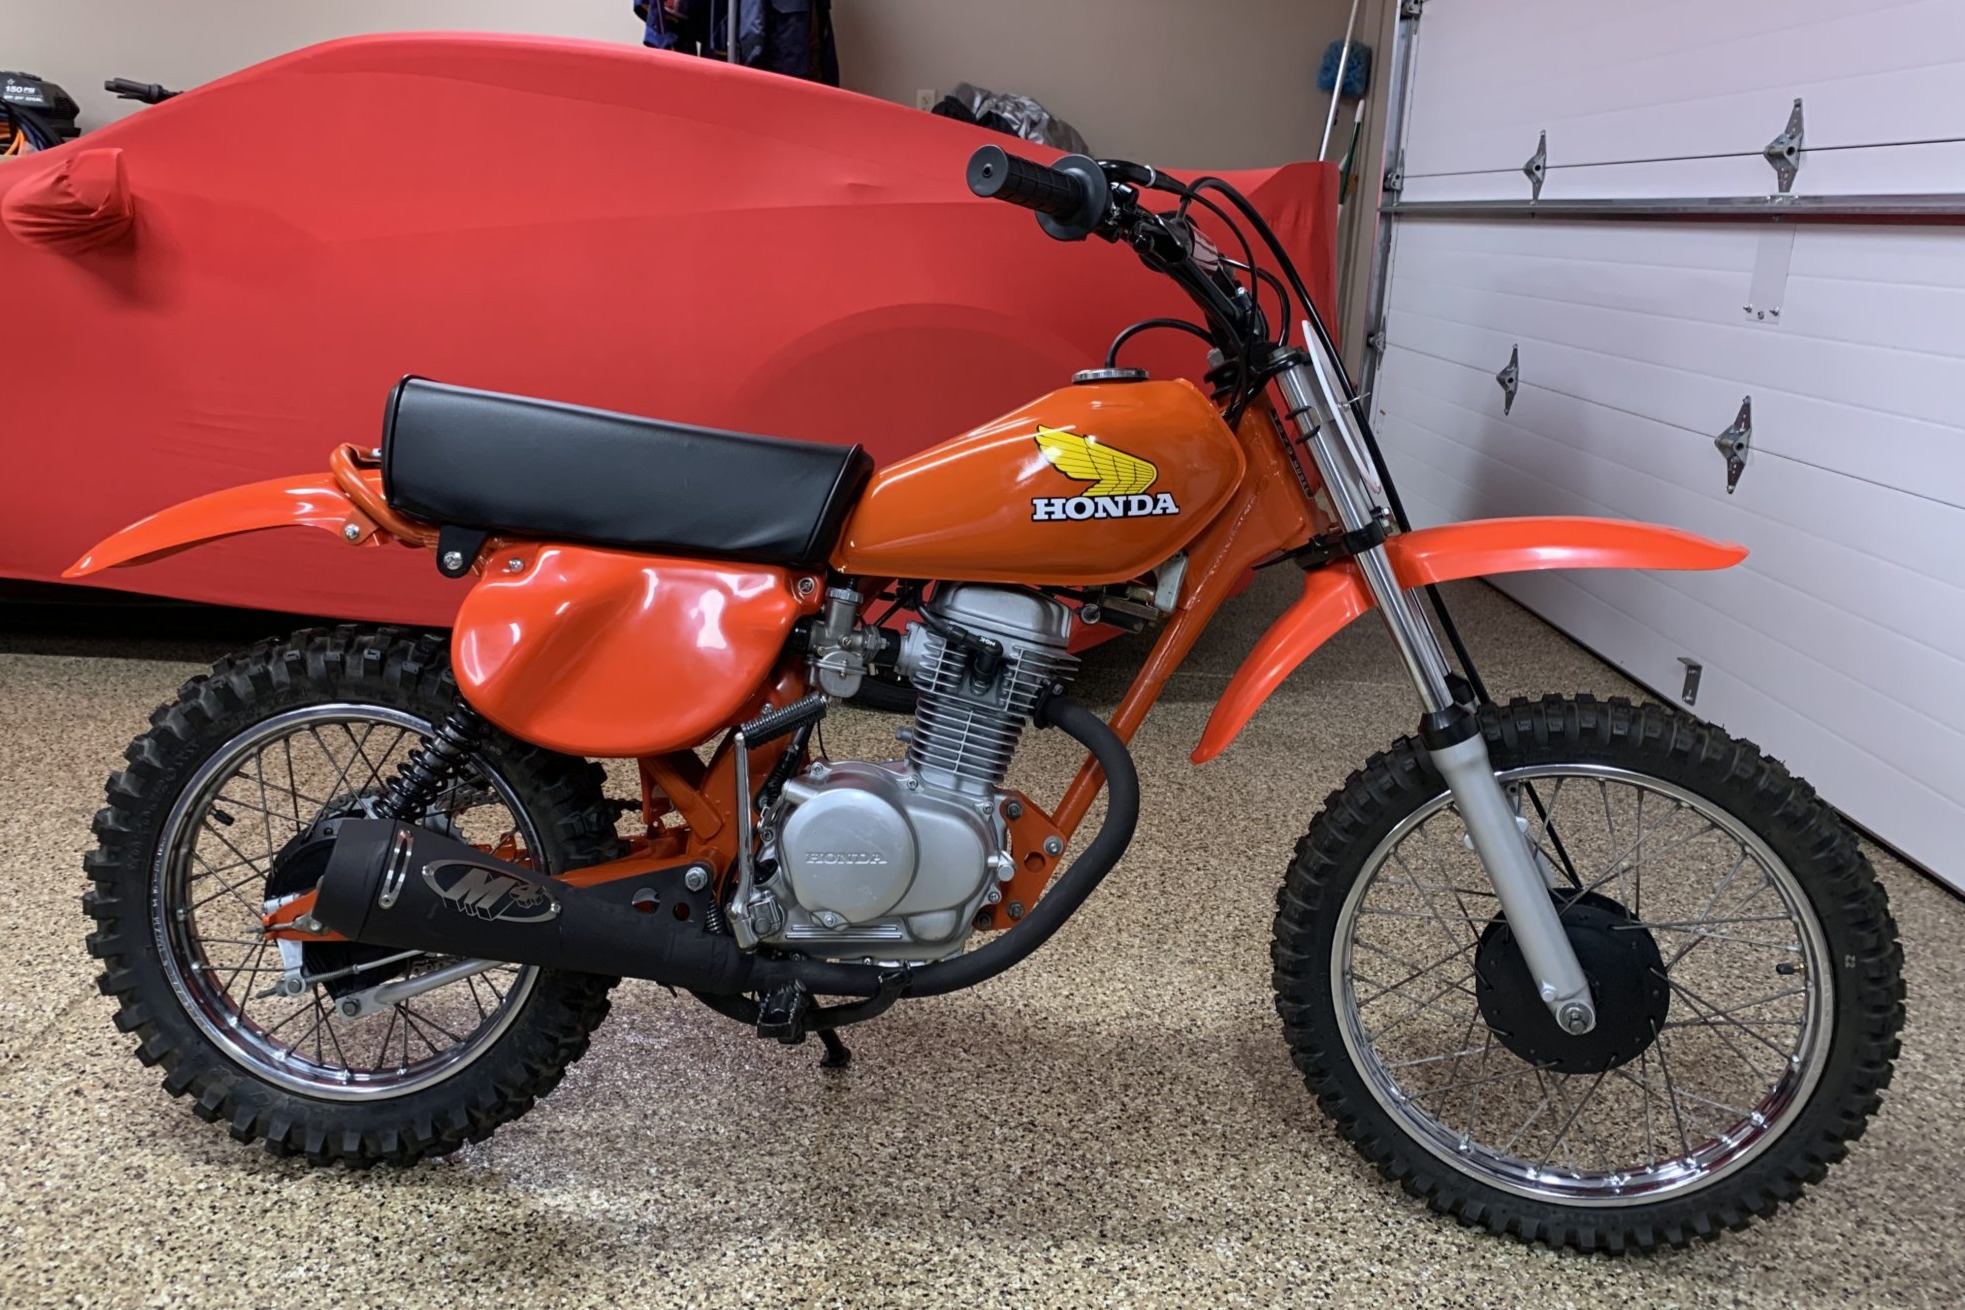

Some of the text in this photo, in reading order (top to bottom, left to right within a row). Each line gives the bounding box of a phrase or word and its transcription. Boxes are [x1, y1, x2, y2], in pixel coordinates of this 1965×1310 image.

[5, 85, 23, 93] 150
[1032, 493, 1180, 521] HONDA
[806, 852, 888, 865] HONDA
